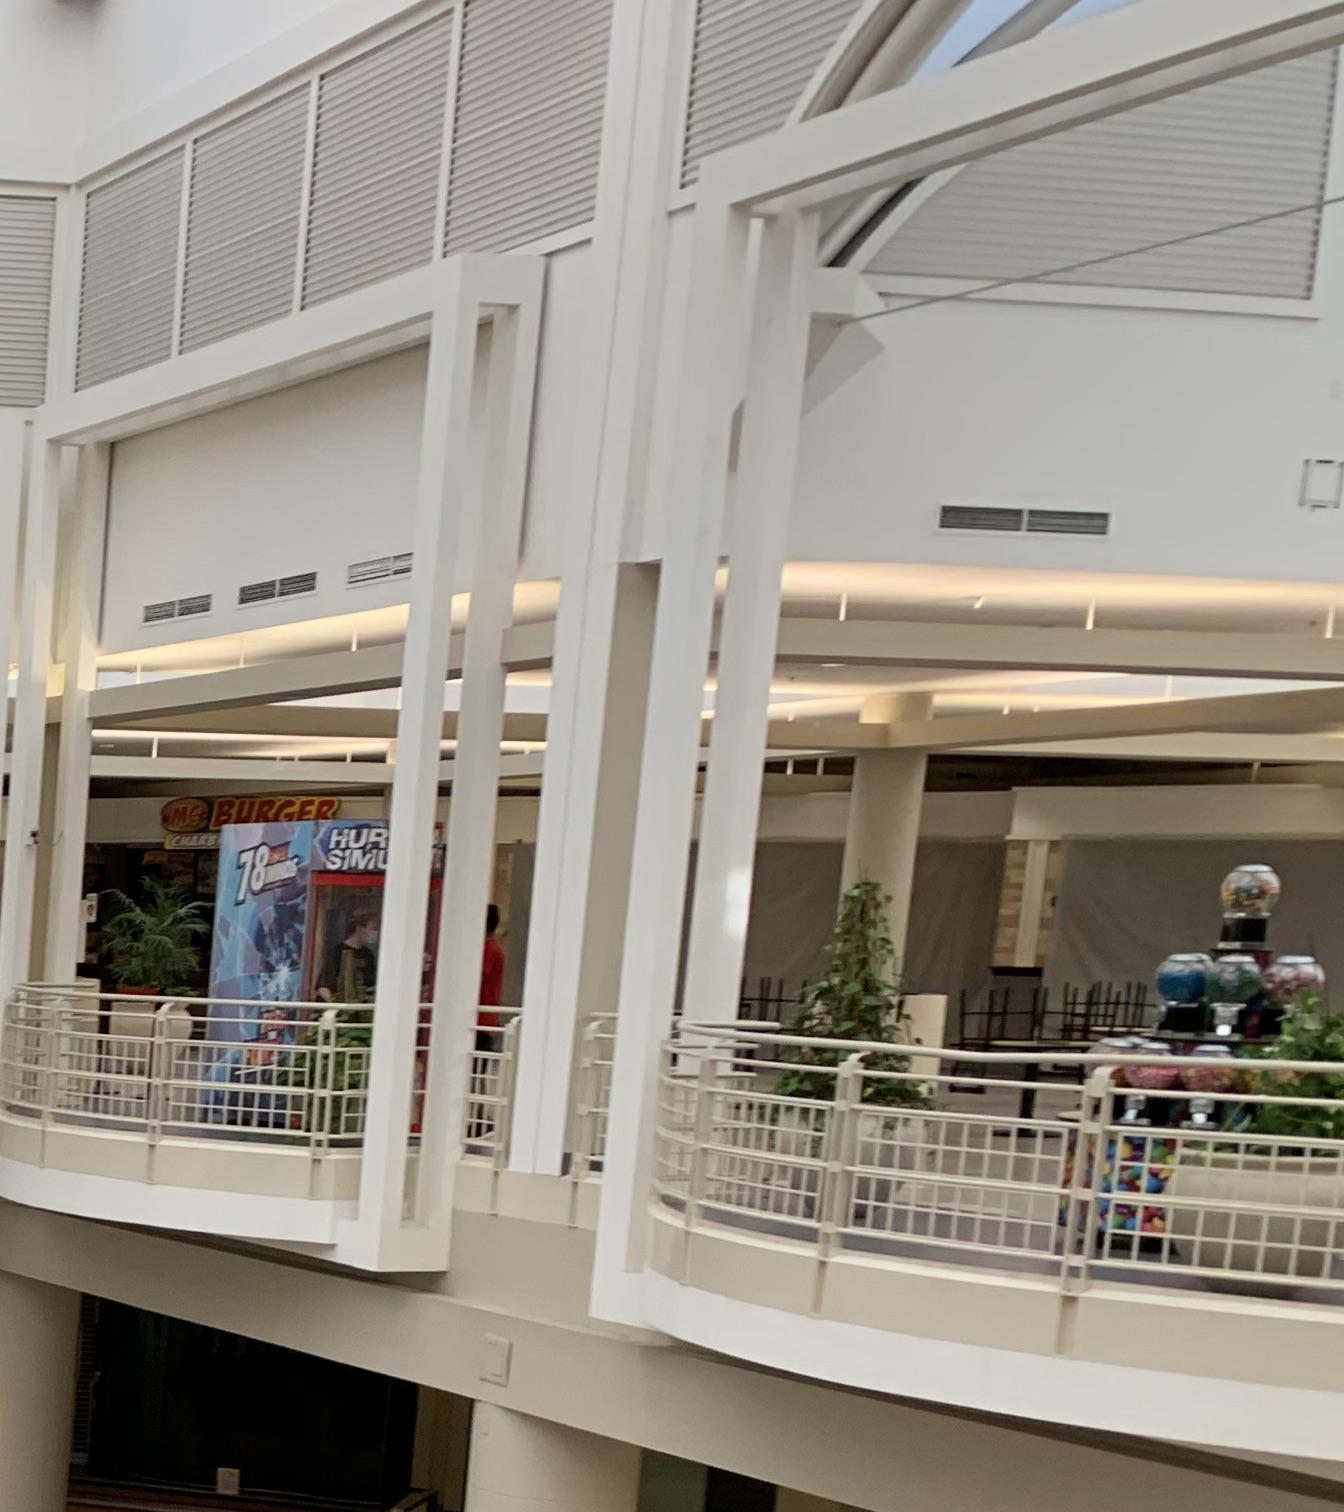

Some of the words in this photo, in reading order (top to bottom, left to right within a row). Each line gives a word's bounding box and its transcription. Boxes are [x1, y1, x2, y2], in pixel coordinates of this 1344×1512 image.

[212, 799, 336, 827] BURGER
[329, 828, 389, 849] HUR
[326, 848, 389, 870] SIMU
[235, 844, 271, 903] 78
